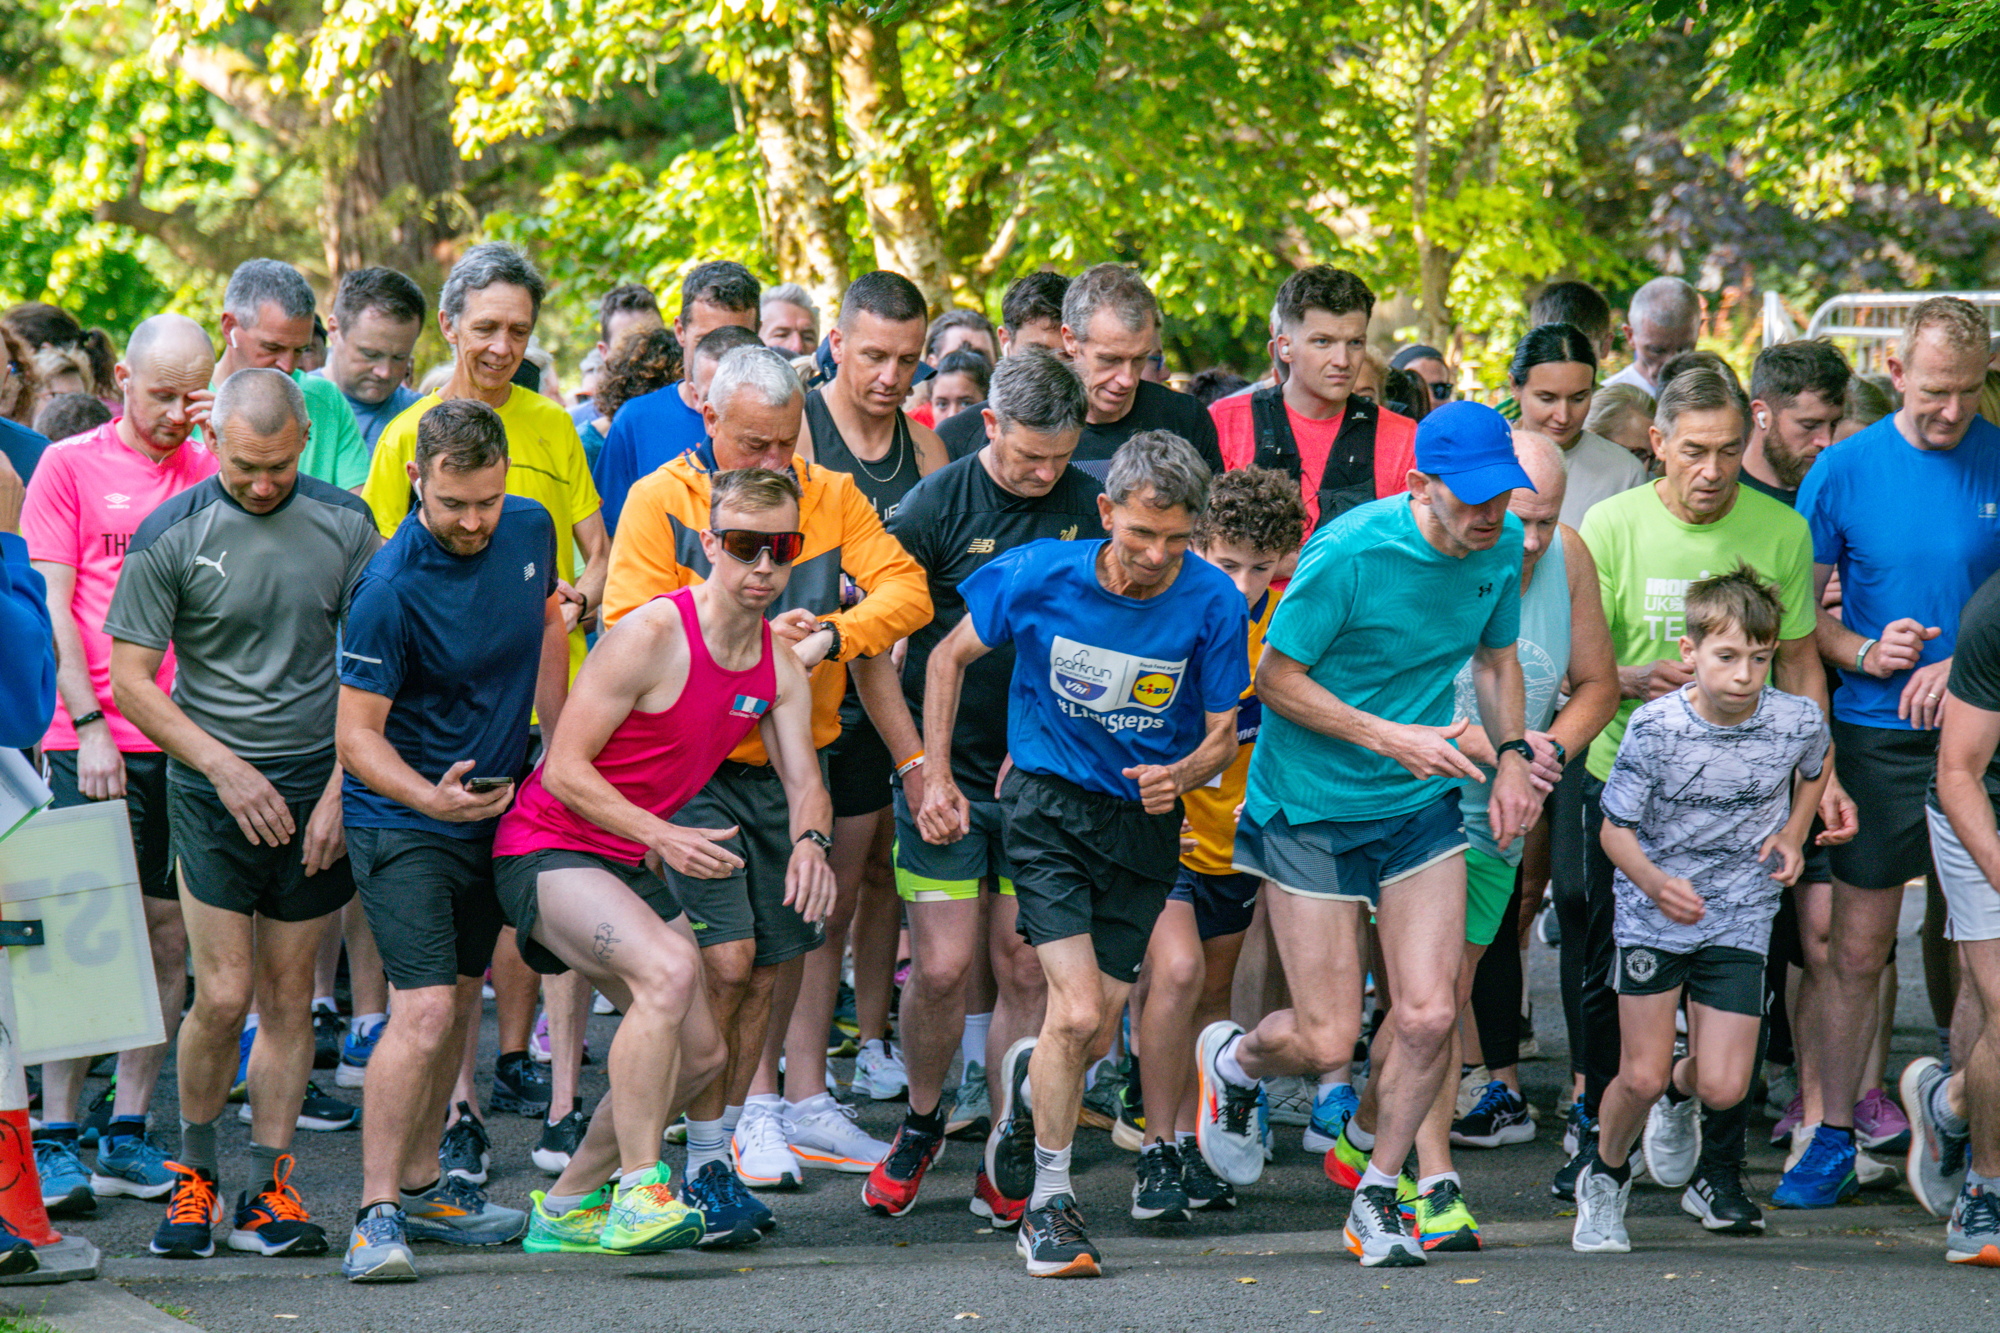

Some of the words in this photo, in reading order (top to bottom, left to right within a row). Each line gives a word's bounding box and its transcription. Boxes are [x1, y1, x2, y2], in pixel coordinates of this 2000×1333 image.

[101, 533, 135, 556] TH
[1644, 596, 1670, 612] UK
[1054, 656, 1112, 680] parkrun
[1532, 646, 1552, 669] WITH
[1064, 680, 1088, 695] Vhi
